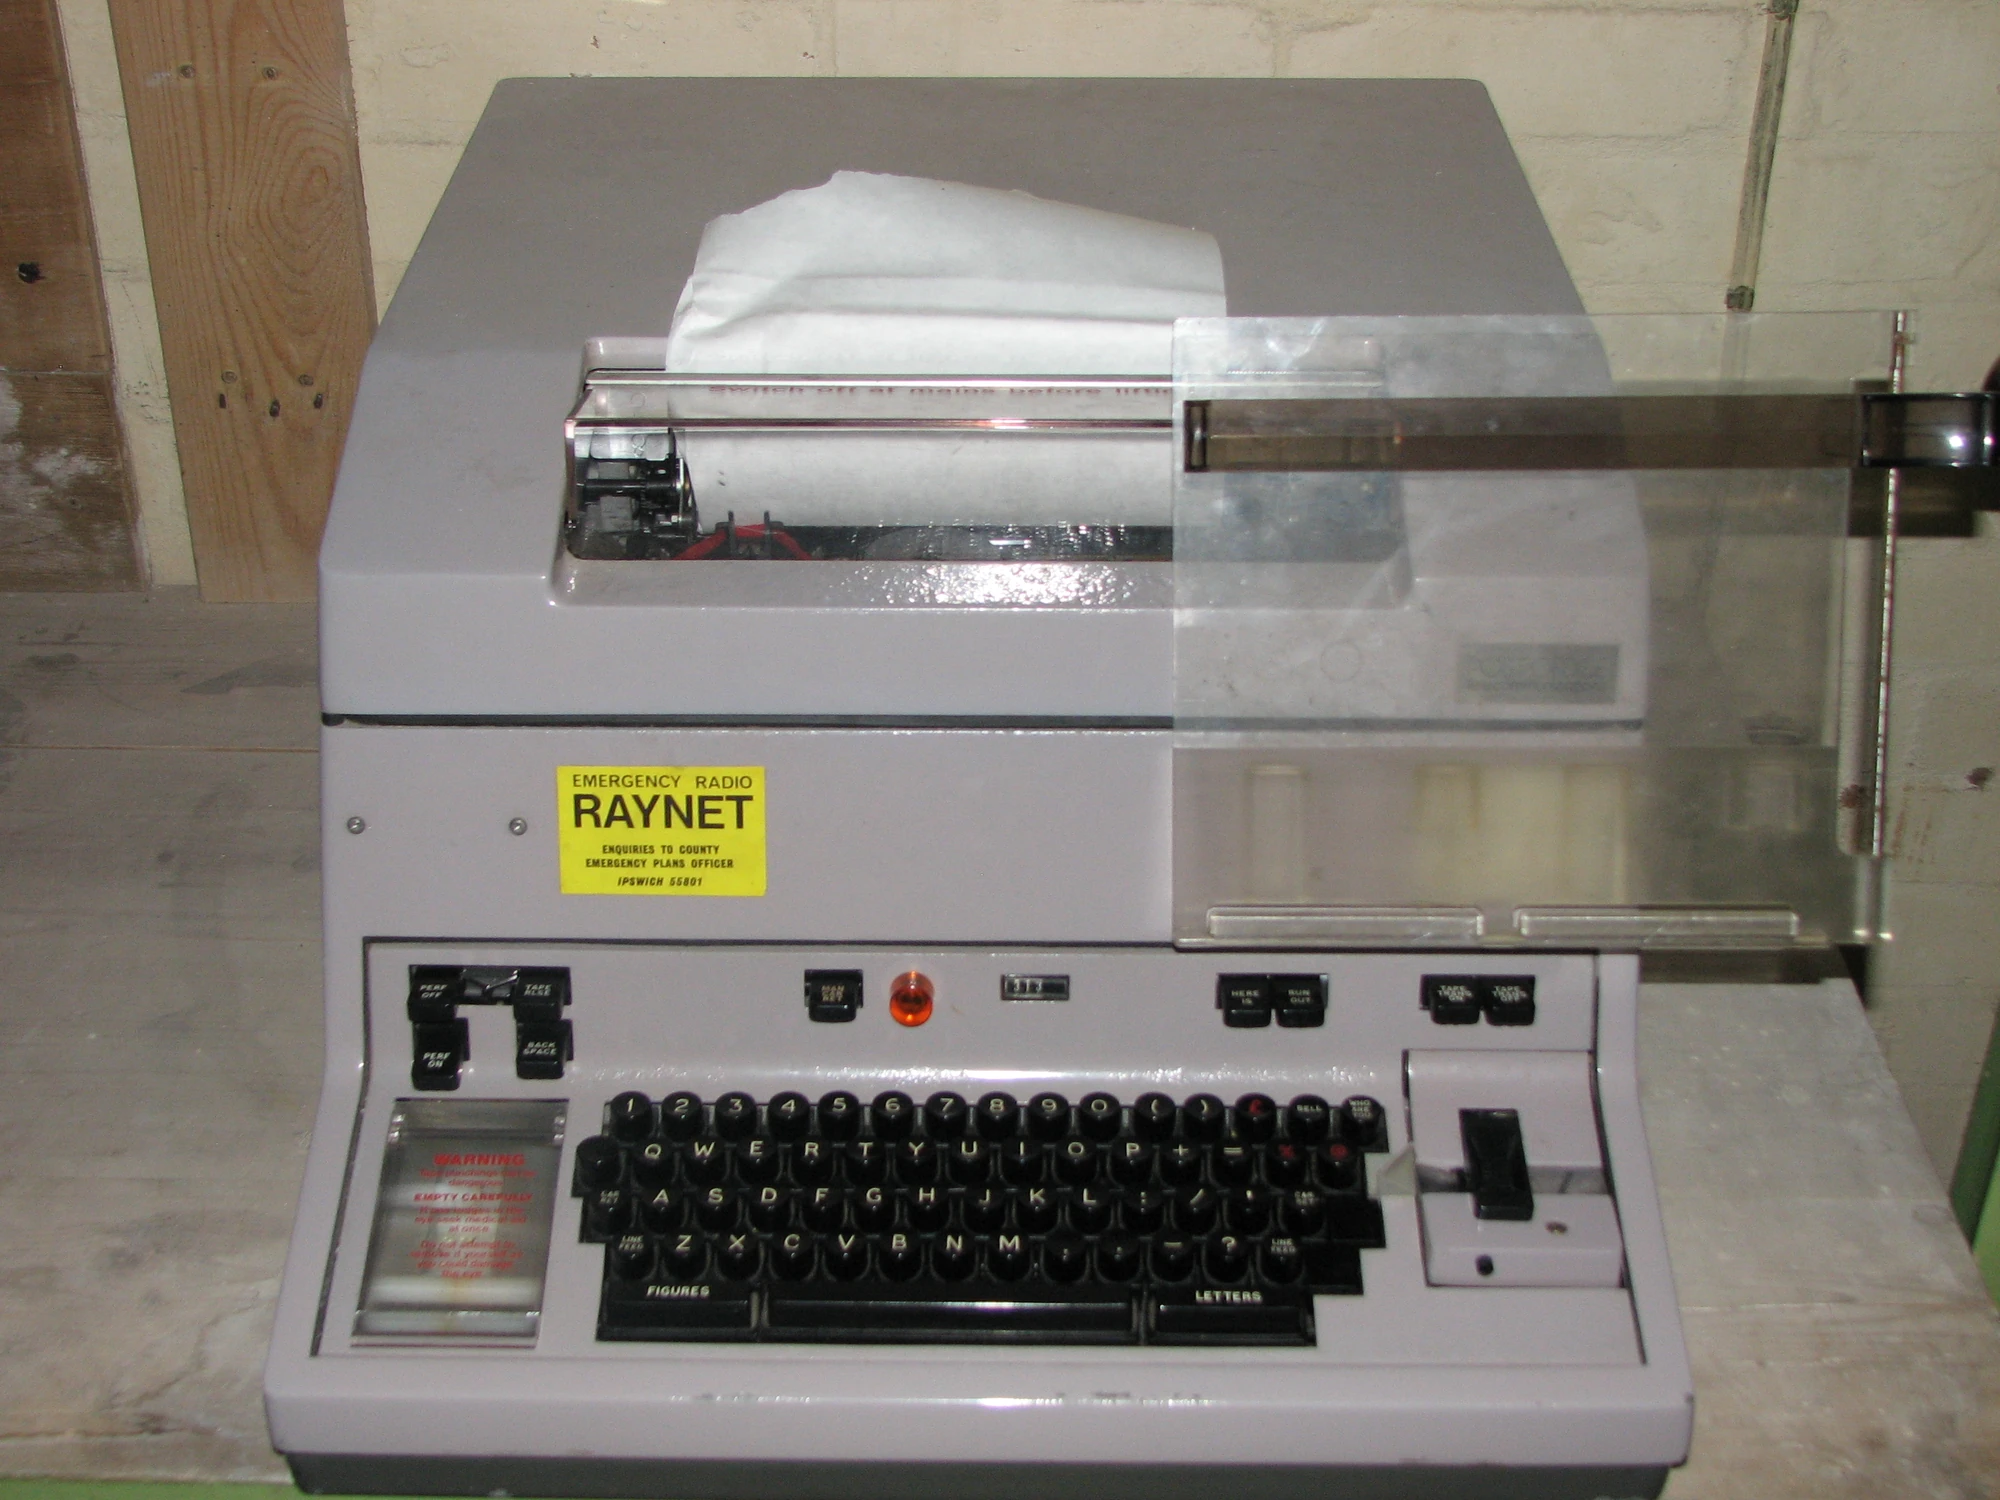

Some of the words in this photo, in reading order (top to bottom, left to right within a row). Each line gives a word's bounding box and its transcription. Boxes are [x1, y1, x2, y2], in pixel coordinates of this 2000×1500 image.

[573, 774, 681, 788] EMERGENCY
[696, 775, 752, 789] RADIO
[573, 793, 753, 829] RAYNET
[602, 845, 654, 854] ENQUIRIES
[661, 845, 673, 854] TO
[679, 845, 719, 854] COUNTY
[586, 859, 646, 868] EMERGENCY
[653, 859, 685, 868] PLANS
[692, 859, 733, 868] OFFICER
[618, 877, 663, 886] IPSWICH
[670, 877, 702, 886] 55801
[628, 1099, 633, 1112] 1
[675, 1099, 688, 1112] 2
[730, 1099, 742, 1112] 3
[782, 1100, 795, 1112] 4
[833, 1098, 846, 1111] 5
[886, 1098, 900, 1111] 6
[941, 1098, 953, 1111] 7
[990, 1099, 1004, 1112] 8
[1042, 1099, 1056, 1112] 9
[645, 1144, 661, 1159] Q
[695, 1142, 714, 1156] W
[750, 1141, 762, 1155] E
[805, 1142, 818, 1156] R
[859, 1143, 872, 1156] T
[909, 1142, 923, 1155] Y
[962, 1142, 977, 1156] U
[1126, 1143, 1139, 1157] P
[434, 1154, 524, 1165] WARNING
[414, 1193, 458, 1201] EMPTY
[462, 1193, 533, 1201] CAREFULLY
[653, 1189, 668, 1203] A
[709, 1188, 723, 1203] S
[761, 1188, 777, 1202] D
[816, 1188, 828, 1202] F
[867, 1188, 881, 1202] G
[919, 1188, 934, 1201] H
[979, 1189, 990, 1204] J
[1030, 1189, 1044, 1203] K
[1083, 1189, 1096, 1204] L
[676, 1235, 691, 1250] Z
[729, 1235, 745, 1249] X
[784, 1234, 799, 1249] C
[839, 1235, 854, 1250] V
[892, 1234, 906, 1249] B
[947, 1235, 962, 1251] N
[1000, 1235, 1019, 1250] M
[1222, 1237, 1236, 1251] ?
[646, 1285, 710, 1297] FIGURES
[1195, 1290, 1262, 1303] LETTERS
